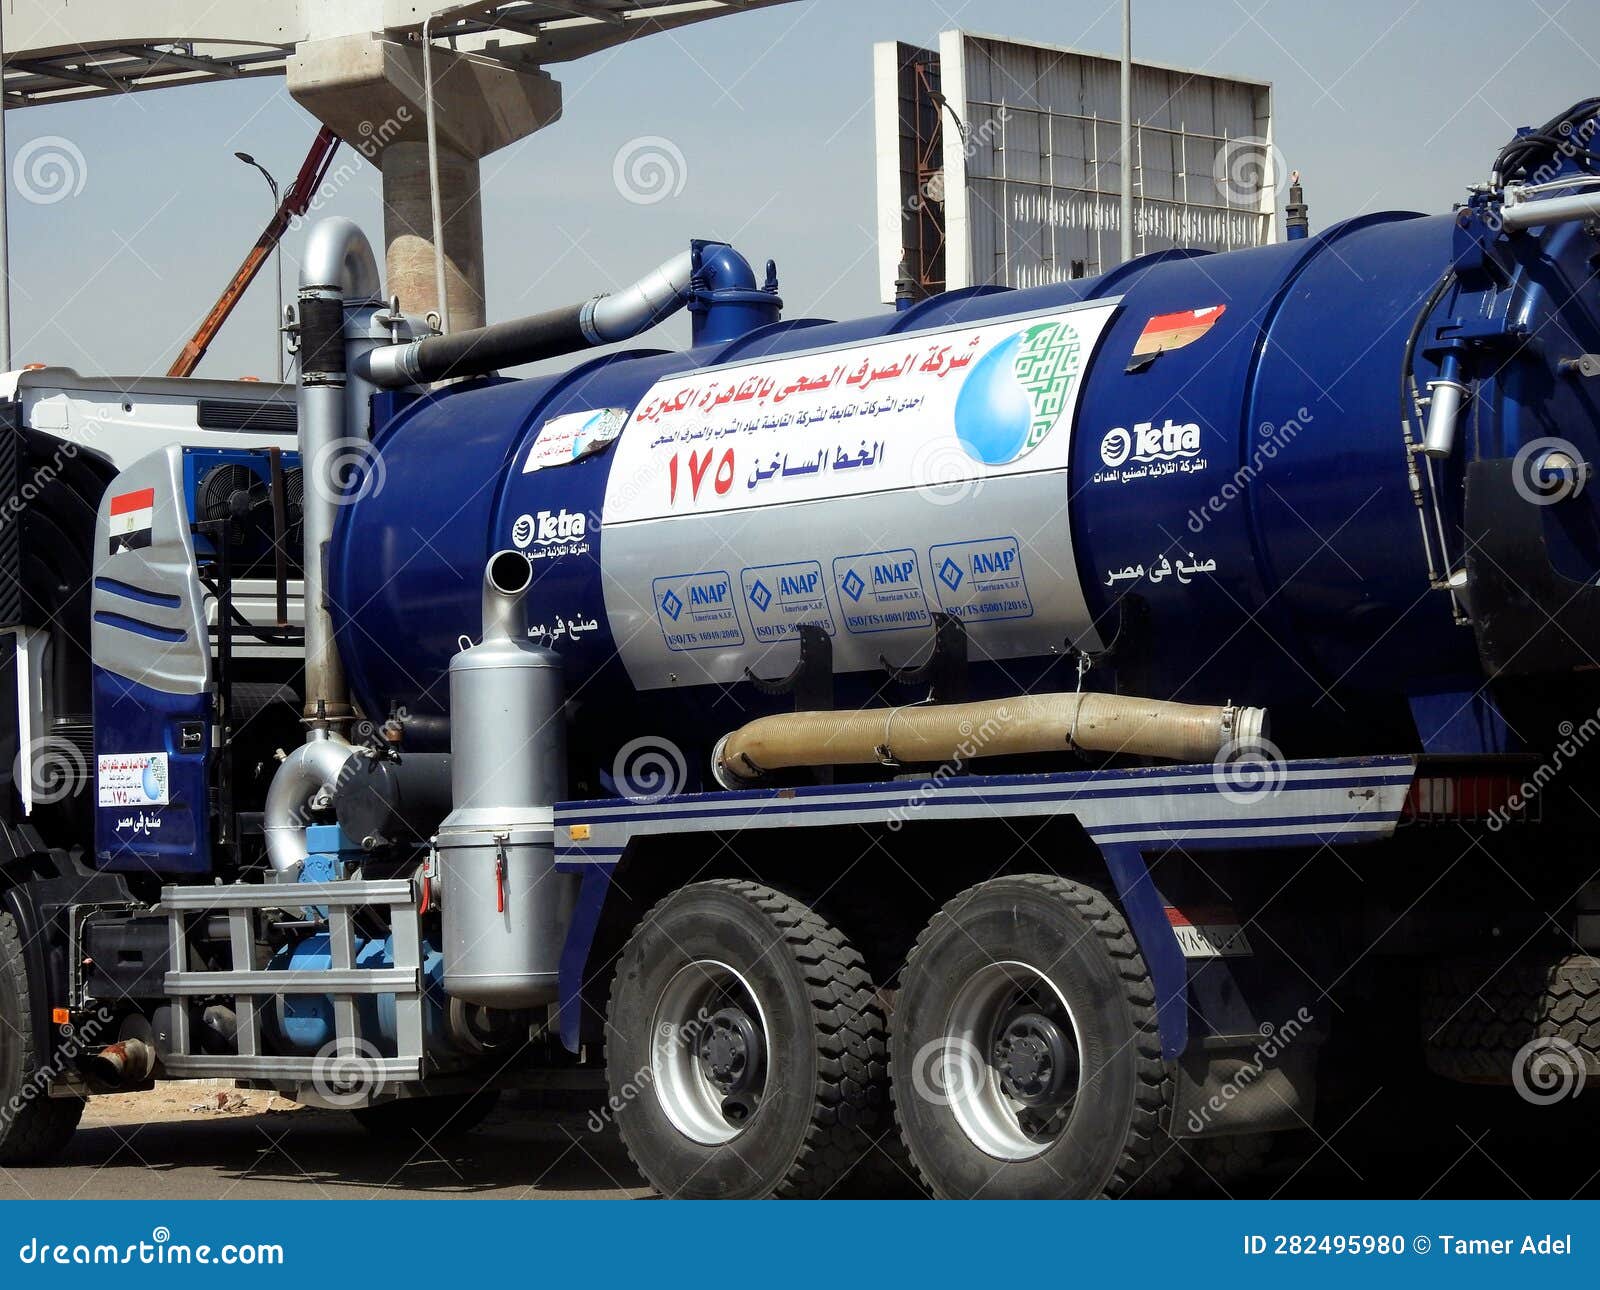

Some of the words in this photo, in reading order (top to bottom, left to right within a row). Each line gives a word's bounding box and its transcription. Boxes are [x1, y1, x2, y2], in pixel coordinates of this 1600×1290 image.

[919, 336, 980, 378] شركة
[846, 353, 919, 389] الصرف
[698, 376, 776, 413] بالقاهرة
[773, 364, 848, 403] الصحى
[636, 388, 700, 423] الكبرى
[796, 406, 828, 427] للشركة
[829, 403, 859, 423] التابعة
[860, 395, 897, 417] الشركات
[714, 418, 742, 439] الشرب
[1133, 420, 1201, 456] Tetra
[832, 439, 885, 470] الخط
[1180, 459, 1207, 474] الشركة
[669, 447, 735, 505] ١٧٥
[747, 448, 829, 489] الساخن
[1093, 468, 1120, 484] المعدات
[1121, 465, 1148, 483] لتصنيع
[537, 508, 586, 539] Tetra
[569, 543, 590, 556] الشركة
[973, 548, 1016, 574] ANAP
[874, 559, 913, 585] ANAP
[1104, 562, 1145, 586] مصر
[1175, 552, 1217, 583] صنع
[691, 581, 727, 605] ANAP
[781, 571, 818, 596] ANAP
[527, 623, 546, 637] مص
[567, 613, 598, 641] صنع
[668, 632, 697, 645] ISO/TS
[113, 791, 128, 804] ١٧٥
[115, 816, 133, 832] مصر
[144, 811, 161, 835] صنع
